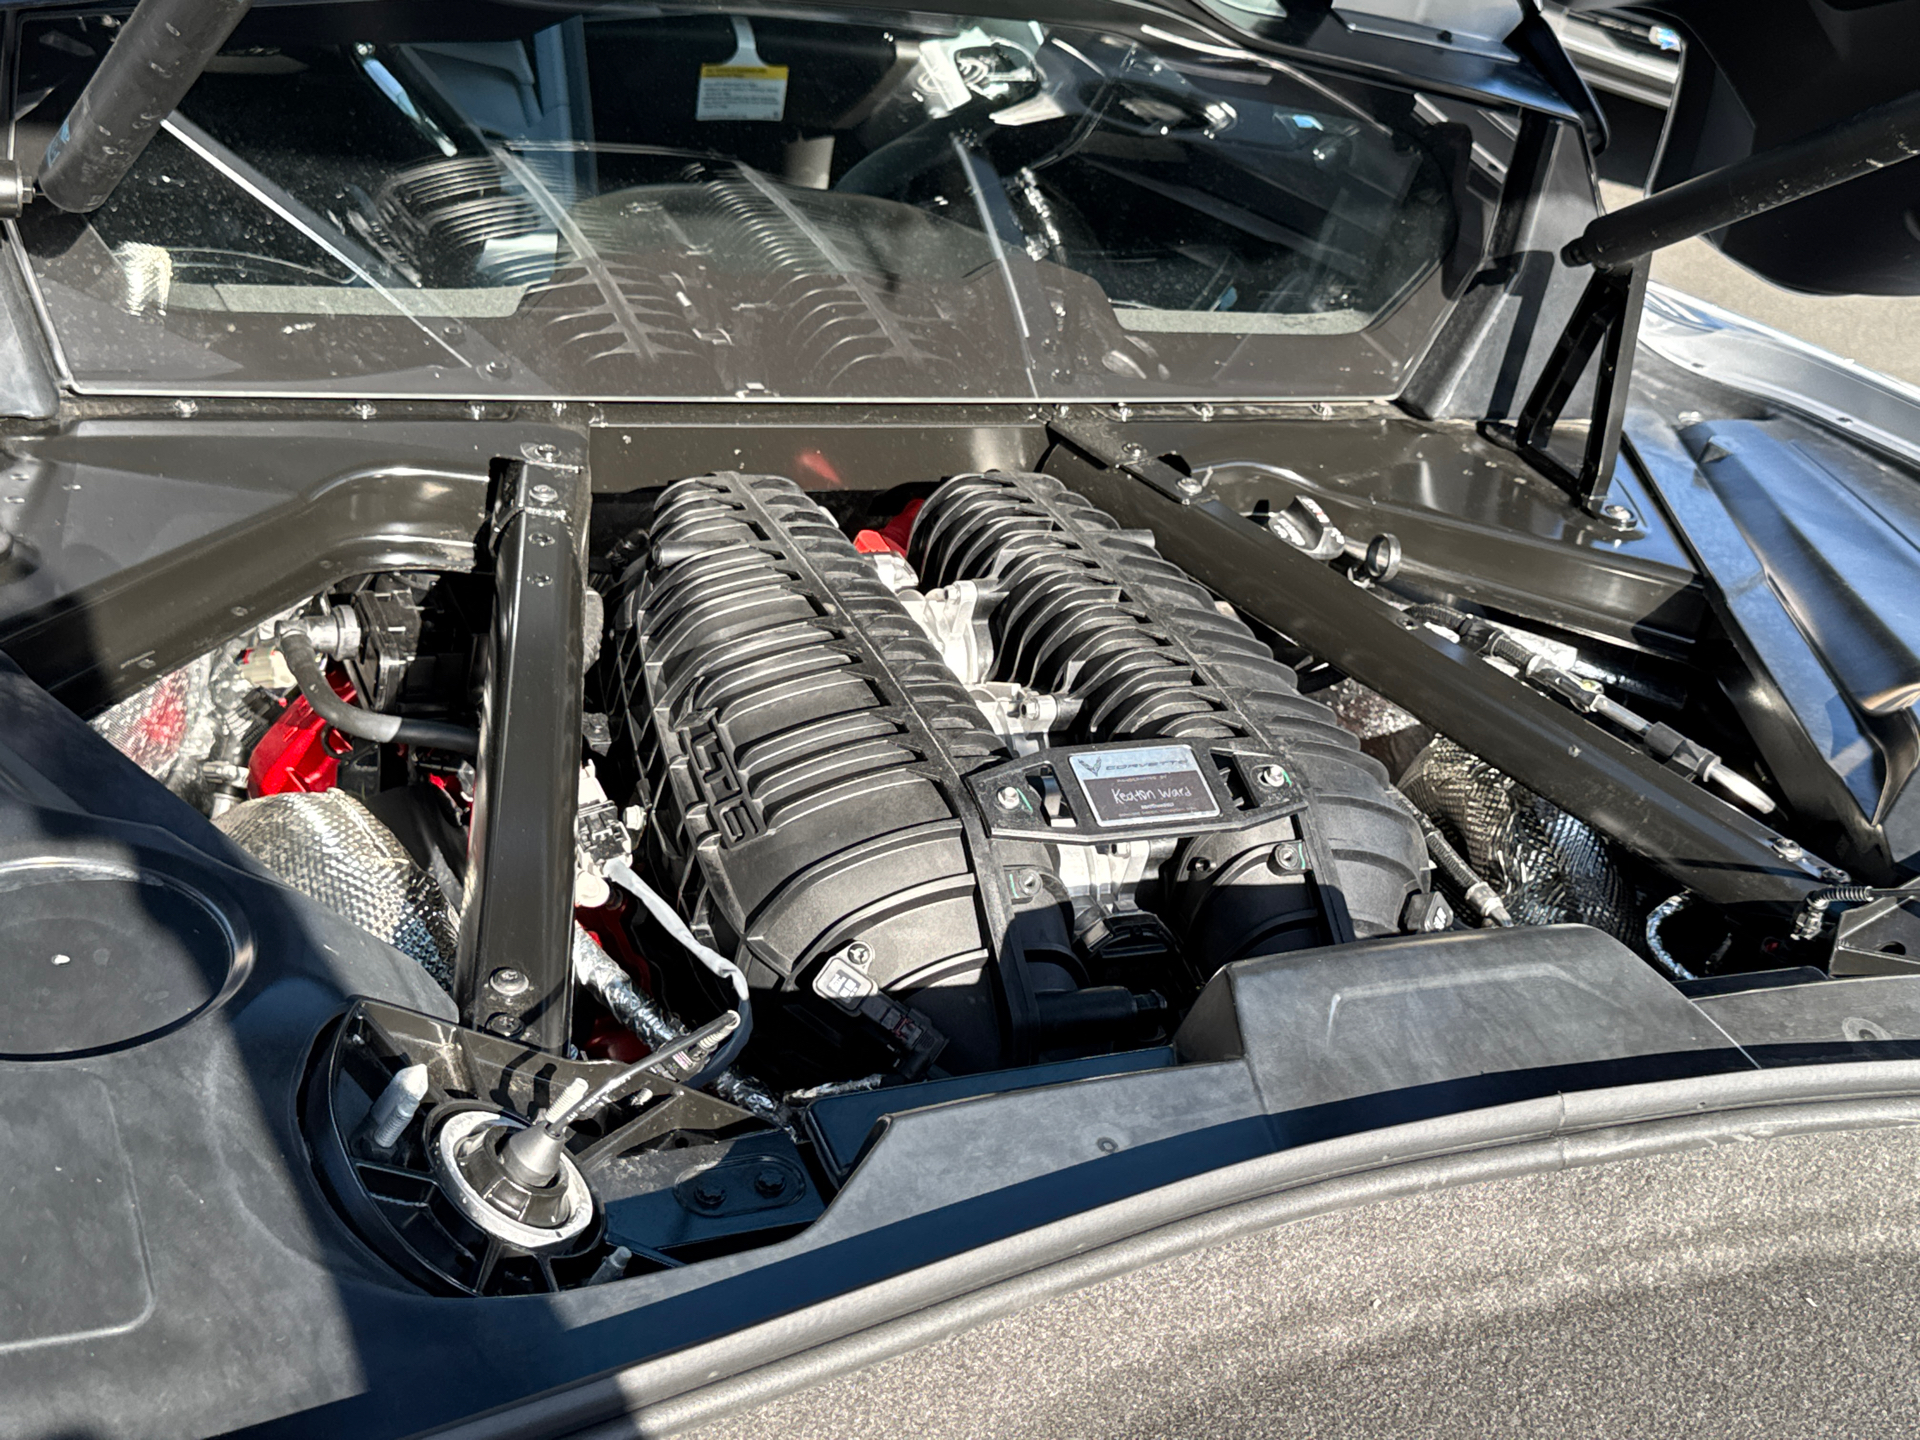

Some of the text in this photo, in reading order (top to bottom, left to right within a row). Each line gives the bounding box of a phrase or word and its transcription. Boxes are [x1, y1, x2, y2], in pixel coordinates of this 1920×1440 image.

[1106, 759, 1188, 771] CORVETTE
[1111, 786, 1192, 805] Keaton Ward
